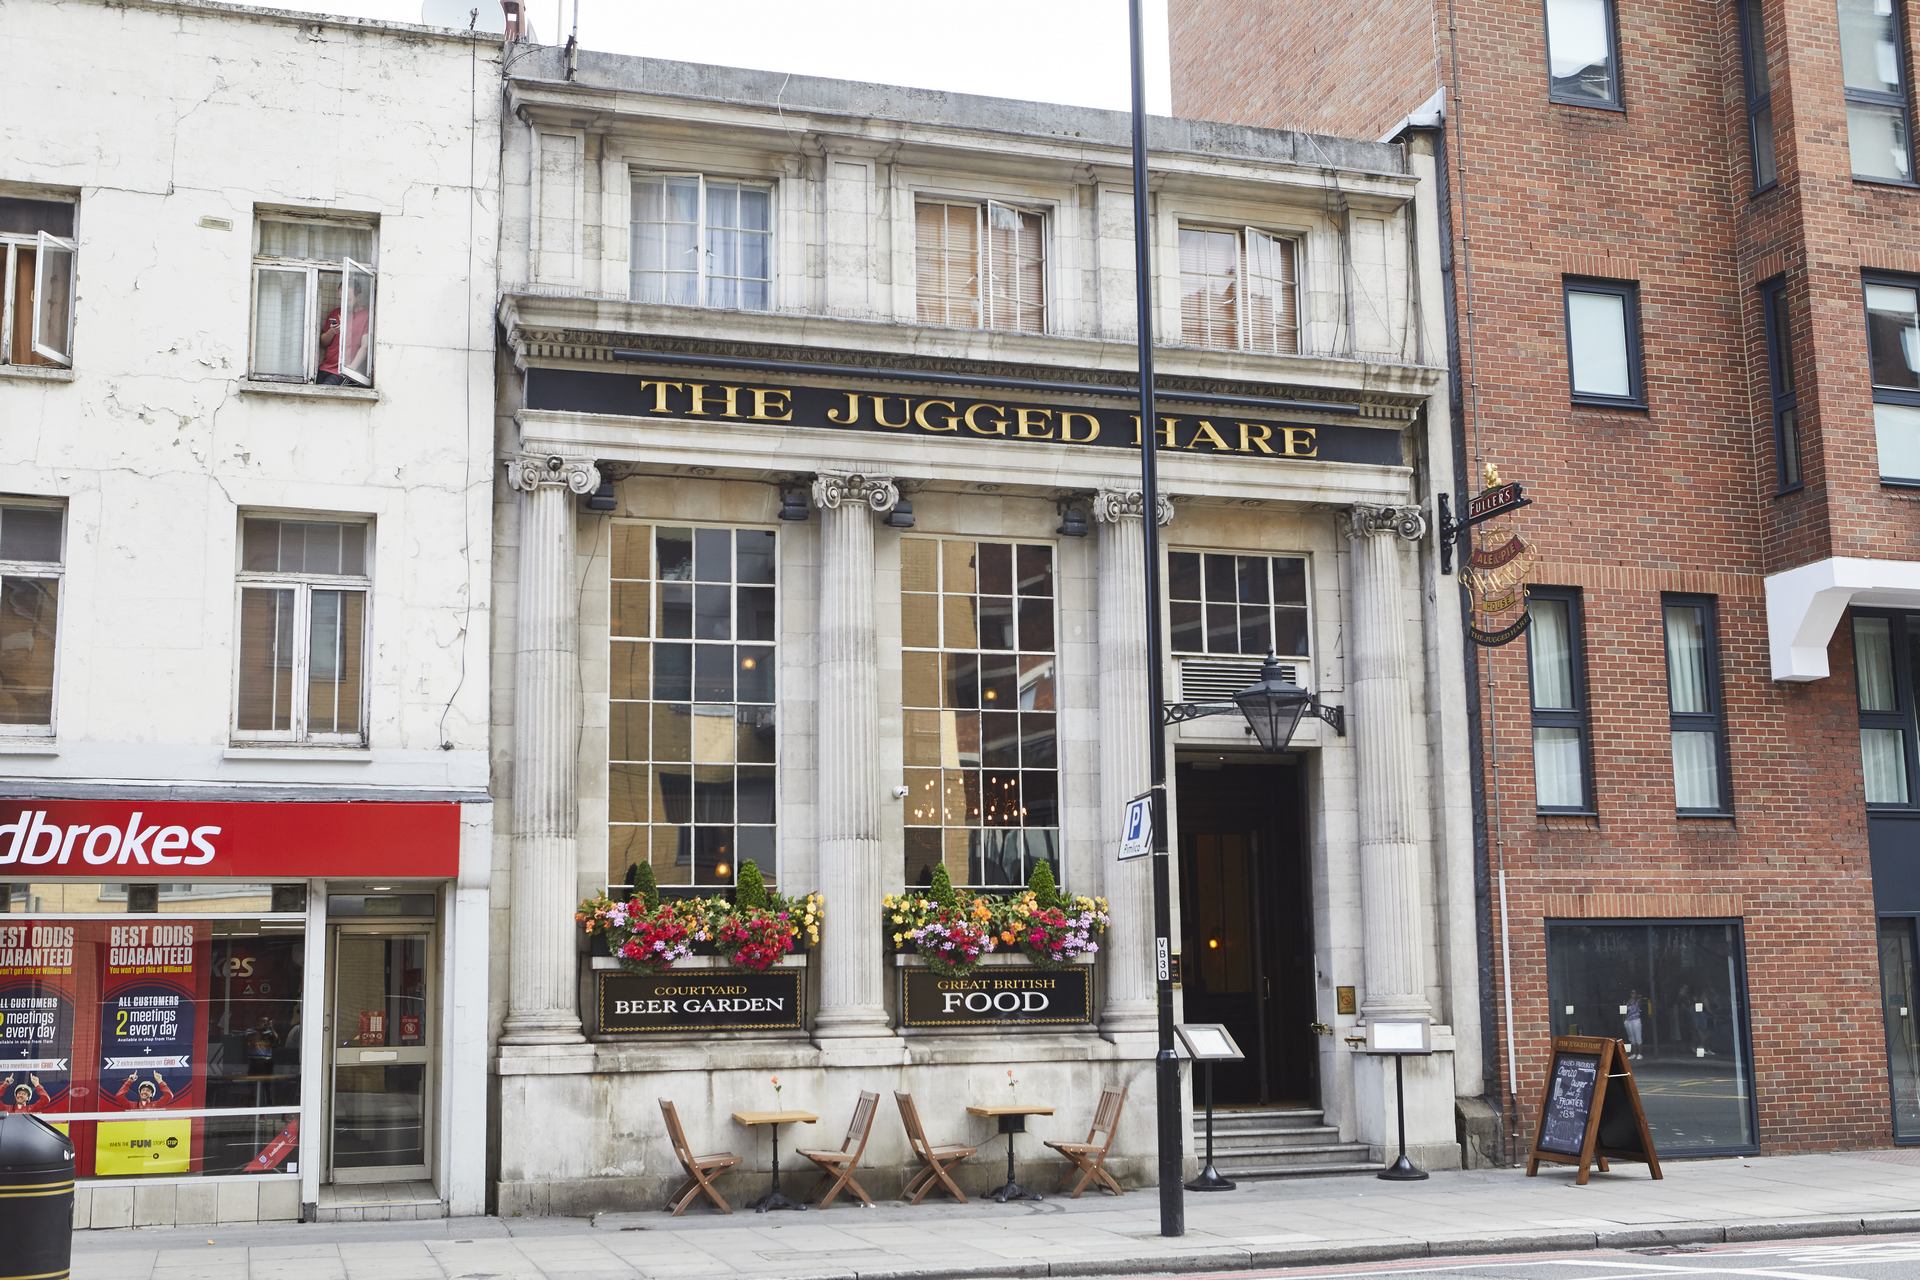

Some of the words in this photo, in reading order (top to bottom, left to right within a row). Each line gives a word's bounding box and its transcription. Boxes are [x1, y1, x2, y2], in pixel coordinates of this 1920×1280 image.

[640, 380, 793, 421] THE
[827, 393, 1100, 443] JUGGED
[1130, 415, 1319, 458] HARE
[1486, 598, 1511, 610] HOUSE
[1129, 806, 1141, 839] P
[32, 926, 74, 948] ODDS
[110, 926, 149, 947] BEST
[152, 925, 194, 947] ODDS
[110, 947, 193, 966] GUARANTEED
[120, 966, 135, 974] won't
[163, 965, 182, 973] William
[183, 965, 192, 973] Hill
[654, 985, 748, 996] COURTYARD
[937, 980, 990, 990] GREAT
[994, 979, 1056, 989] BRITISH
[10, 997, 58, 1008] CUSTOMERS
[118, 997, 132, 1007] ALL
[133, 995, 179, 1007] CUSTOMERS
[615, 1000, 678, 1014] BEER
[683, 997, 785, 1013] GARDEN
[942, 991, 1049, 1013] FOOD
[6, 1010, 54, 1026] meetings
[115, 1010, 128, 1036] 2
[130, 1009, 176, 1024] meetings
[6, 1026, 35, 1040] every
[37, 1023, 56, 1040] day
[129, 1024, 158, 1037] every
[160, 1022, 178, 1036] day
[133, 1059, 156, 1067] meetings
[130, 1139, 152, 1149] FUN
